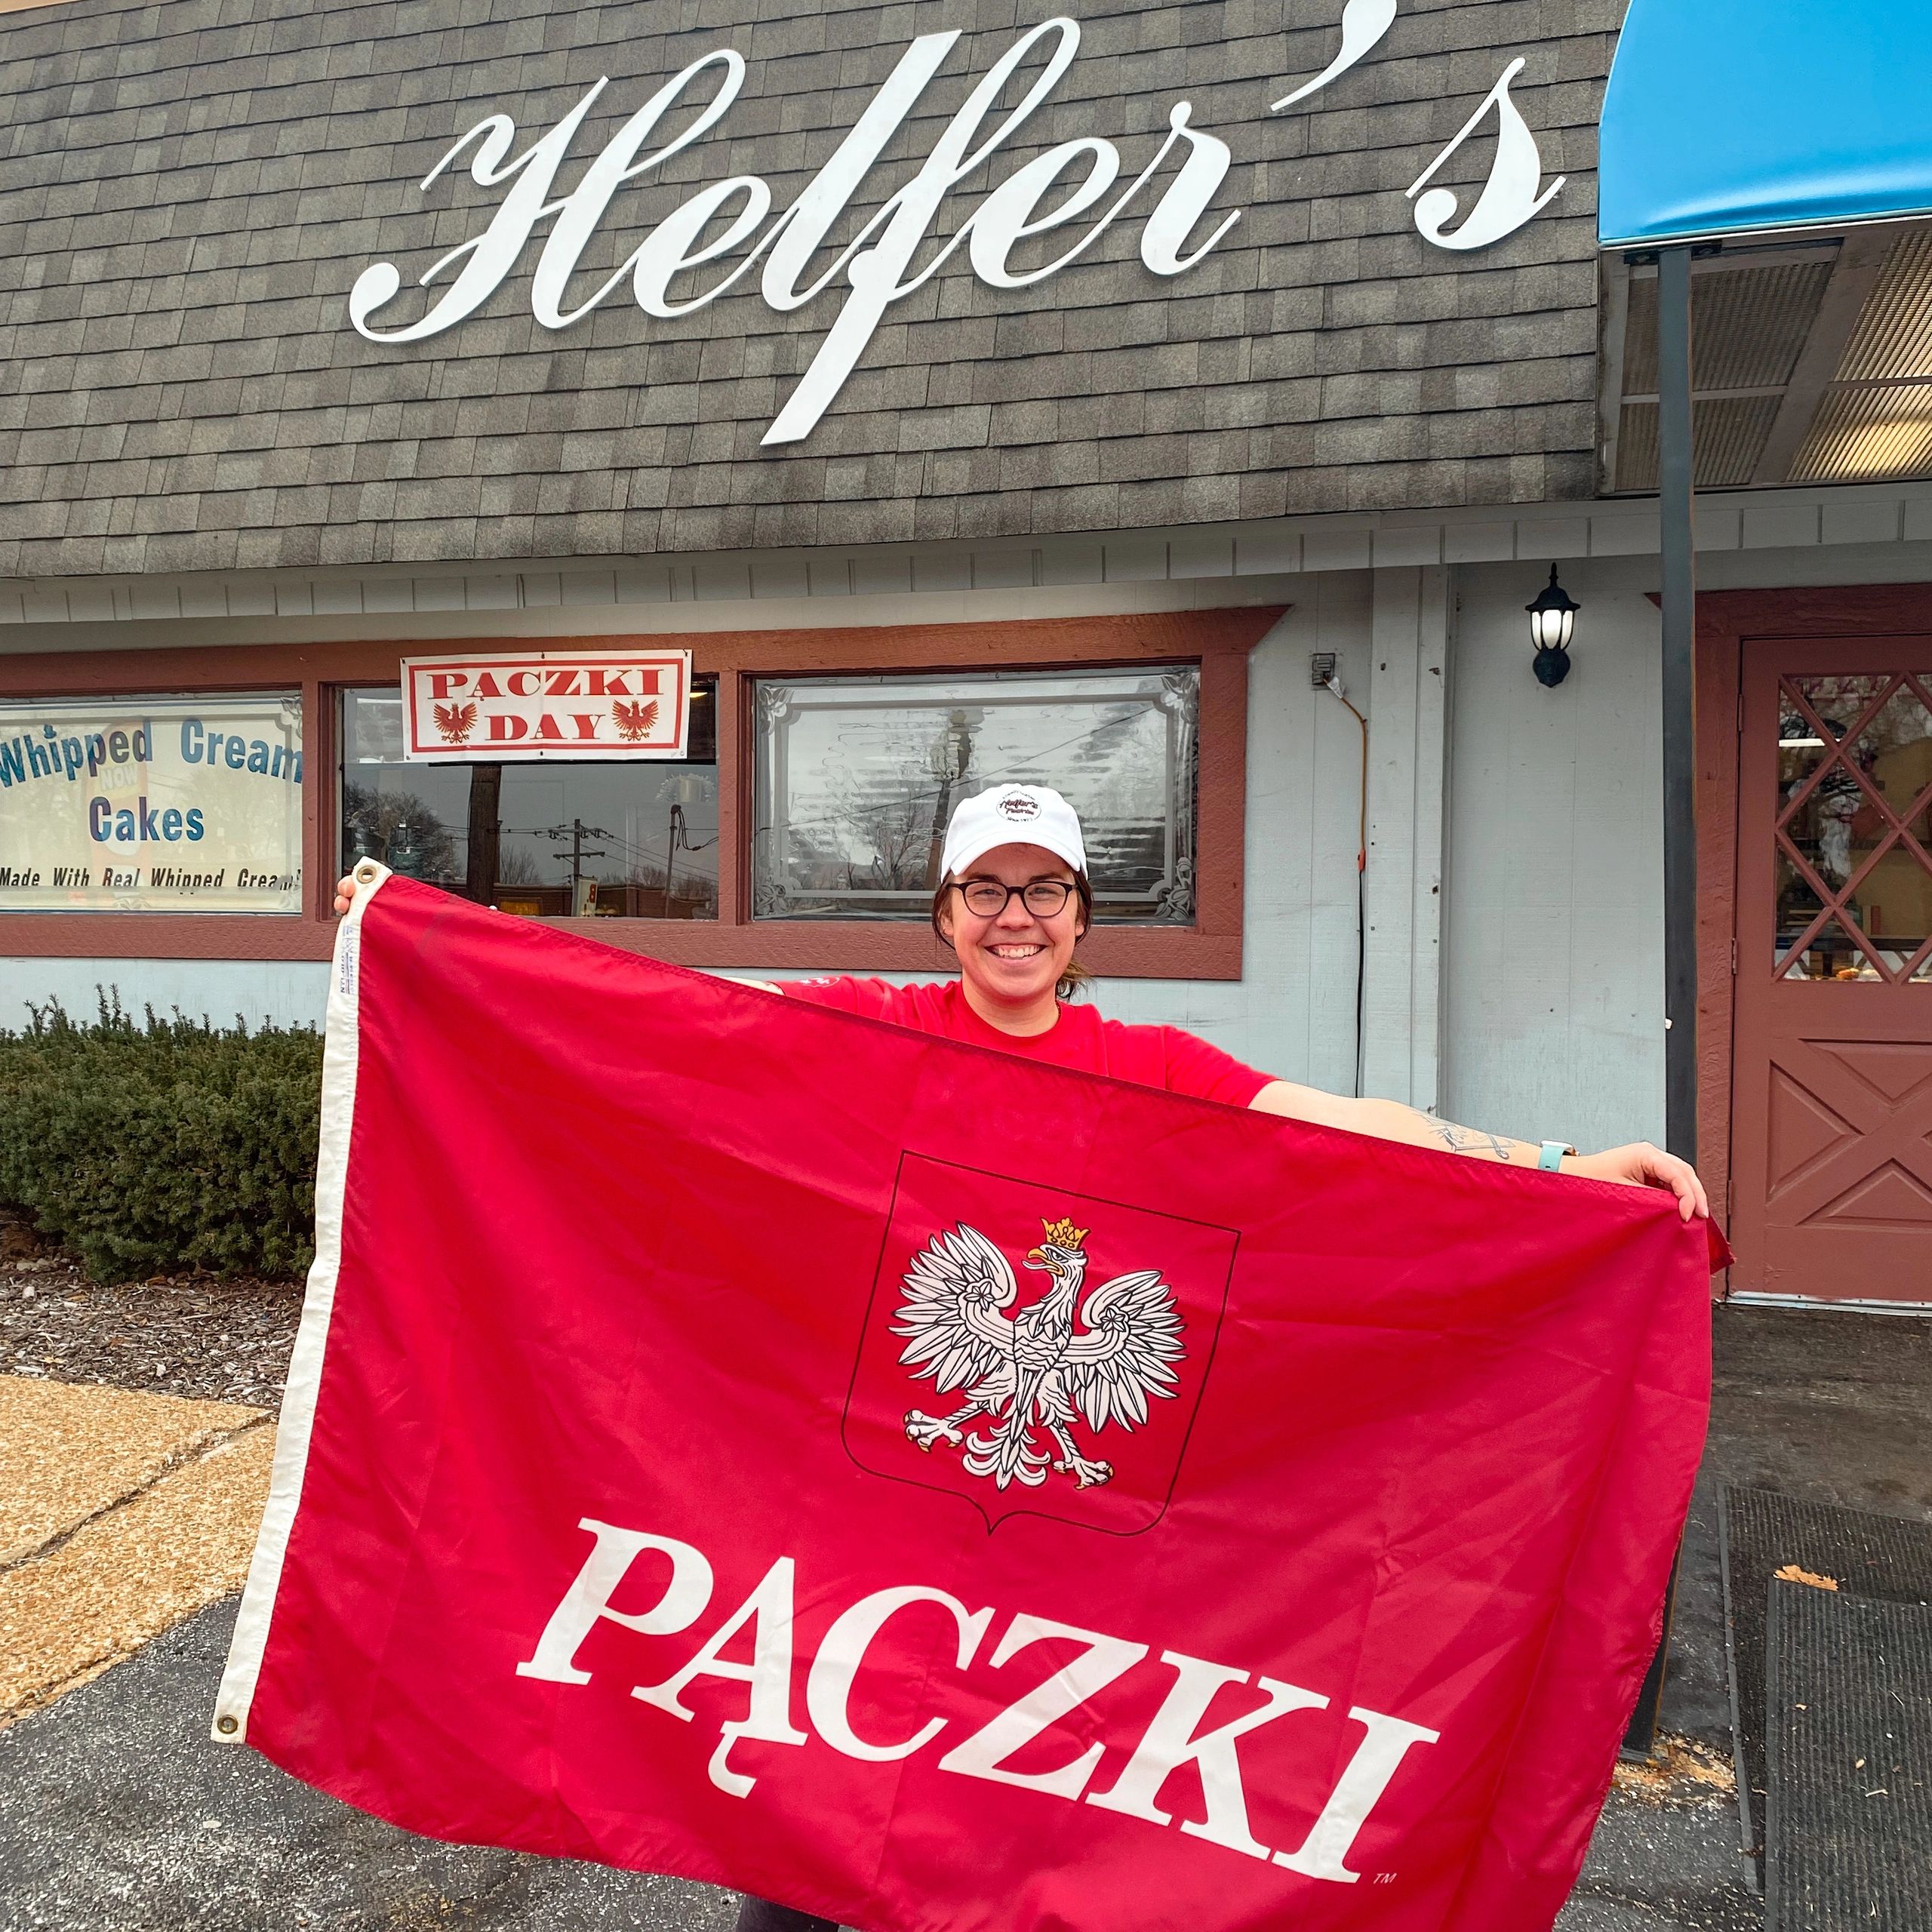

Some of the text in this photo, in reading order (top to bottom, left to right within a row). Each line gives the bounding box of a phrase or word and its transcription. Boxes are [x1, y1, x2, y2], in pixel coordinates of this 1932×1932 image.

[349, 0, 1567, 445] Helfer's
[426, 669, 664, 701] PĄCZKI
[485, 714, 606, 741] DAY
[0, 718, 302, 788] Whipped Cream
[89, 796, 205, 843] Cakes
[0, 867, 41, 887] Made
[53, 867, 90, 887] With
[103, 868, 140, 887] Real
[151, 868, 225, 888] Whipped
[515, 1518, 1440, 1884] PĄCZKI
